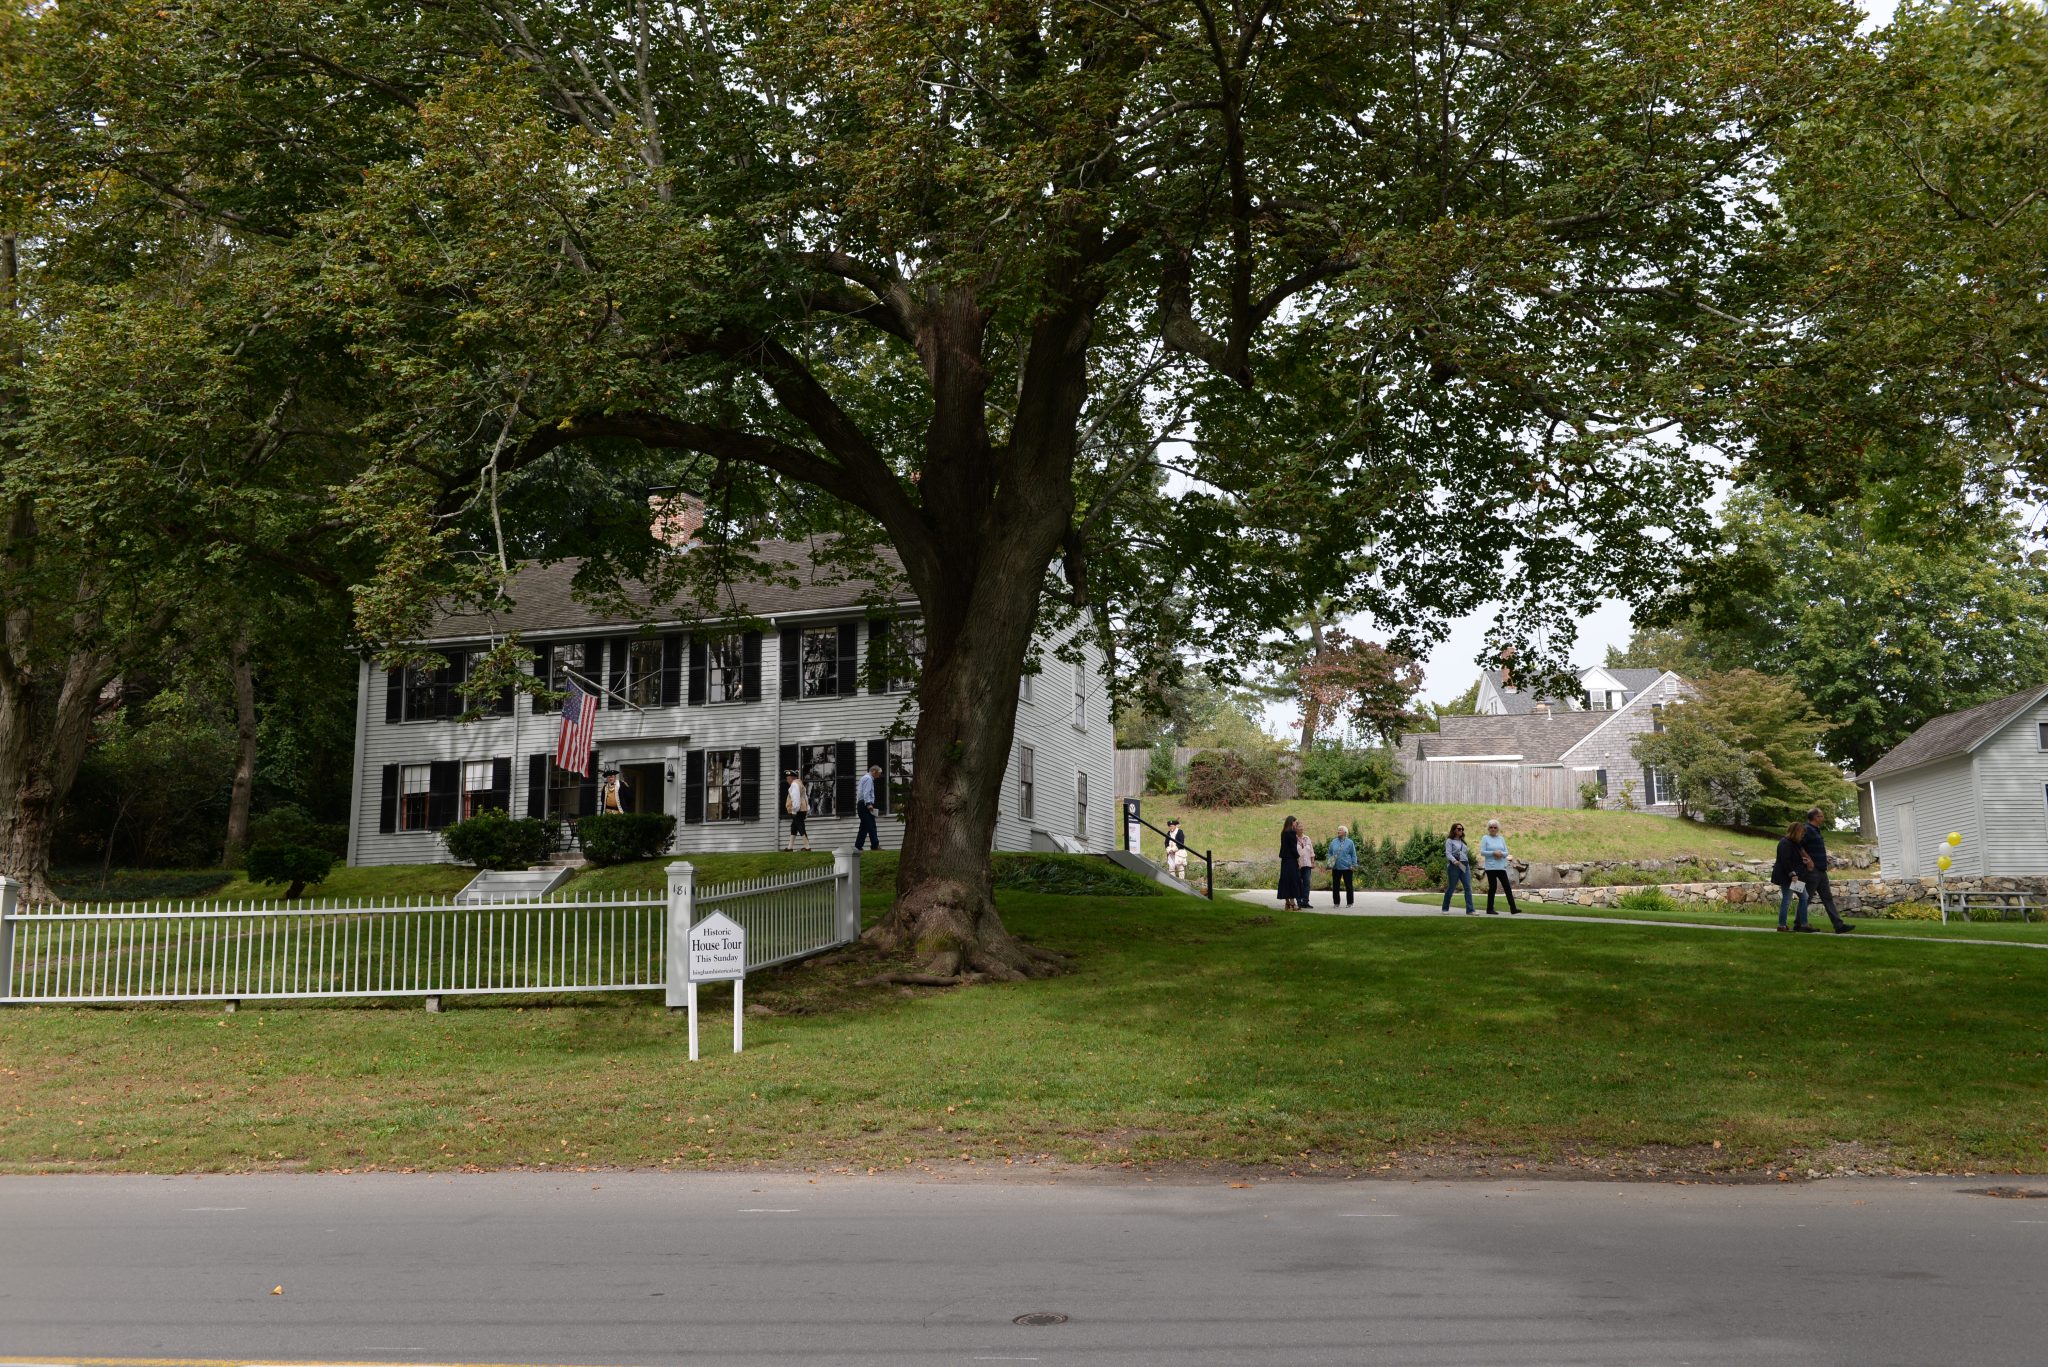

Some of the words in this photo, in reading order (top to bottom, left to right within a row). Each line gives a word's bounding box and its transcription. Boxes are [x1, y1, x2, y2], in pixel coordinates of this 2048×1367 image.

[673, 884, 687, 896] 181
[703, 928, 732, 937] Historic
[692, 939, 720, 951] House
[721, 938, 742, 950] Tour
[696, 955, 711, 963] This
[713, 953, 739, 963] Sunday
